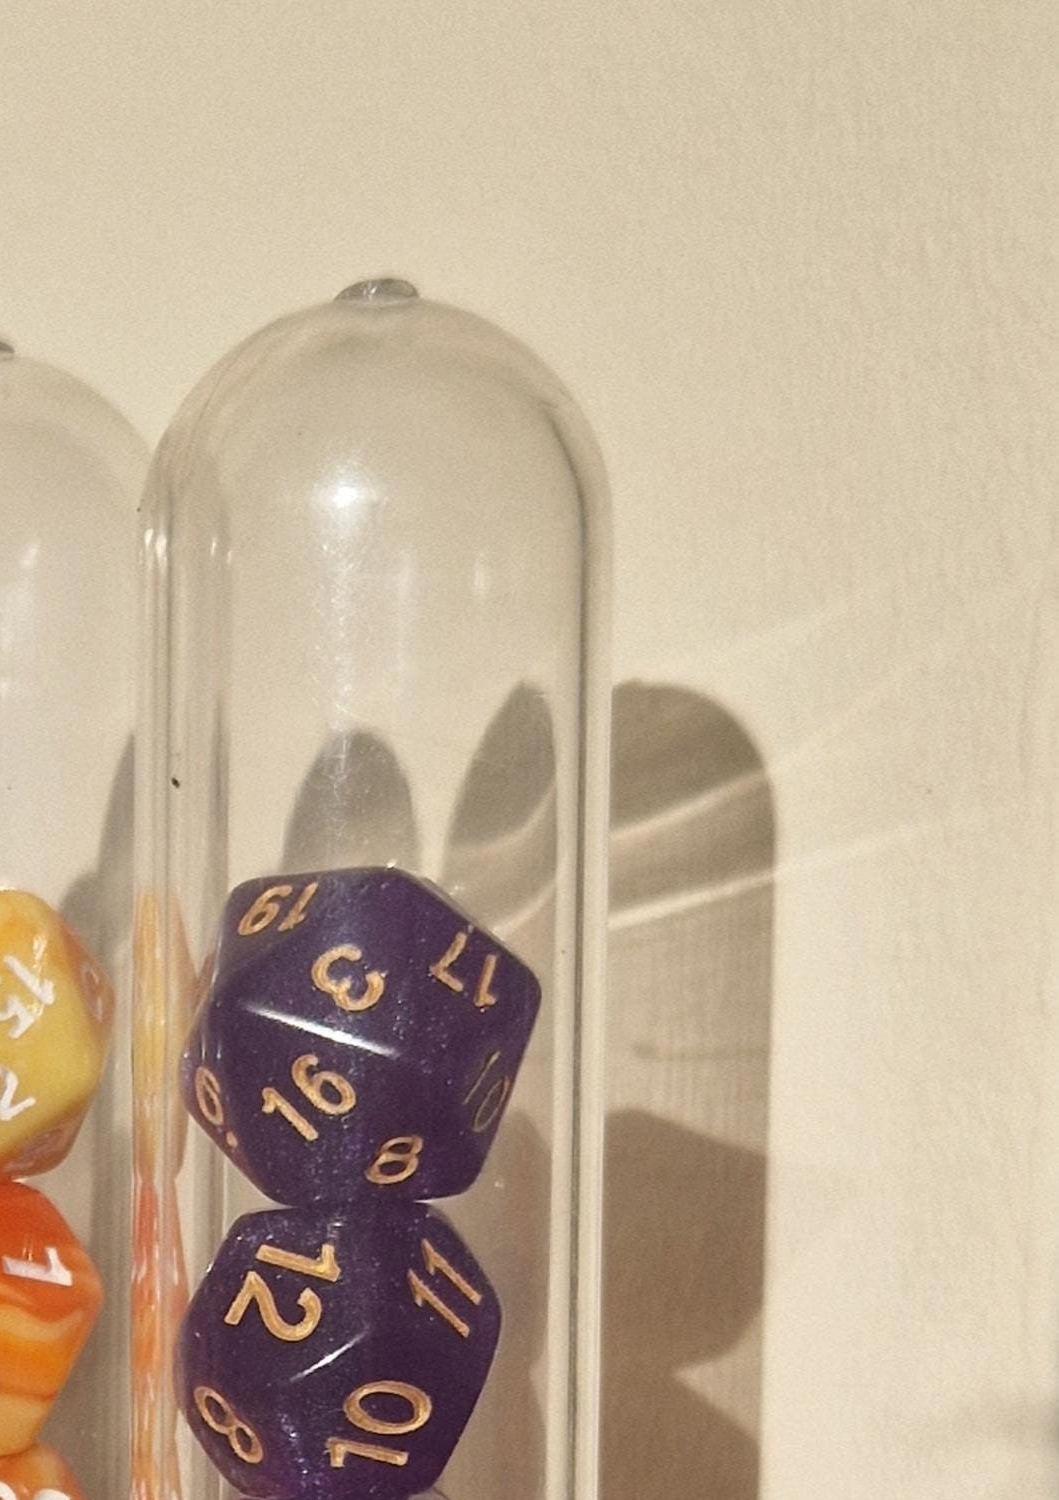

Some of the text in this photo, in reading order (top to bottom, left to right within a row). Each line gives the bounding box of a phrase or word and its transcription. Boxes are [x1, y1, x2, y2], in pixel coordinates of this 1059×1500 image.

[237, 882, 319, 936] 19
[311, 943, 387, 1012] 3
[429, 931, 497, 1008] 17
[262, 1053, 357, 1142] 16
[365, 1135, 423, 1185] 8
[1, 1247, 74, 1287] 1
[223, 1243, 342, 1342] 12
[407, 1238, 482, 1339] 11
[193, 1386, 264, 1464] 8
[325, 1380, 432, 1468] 10
